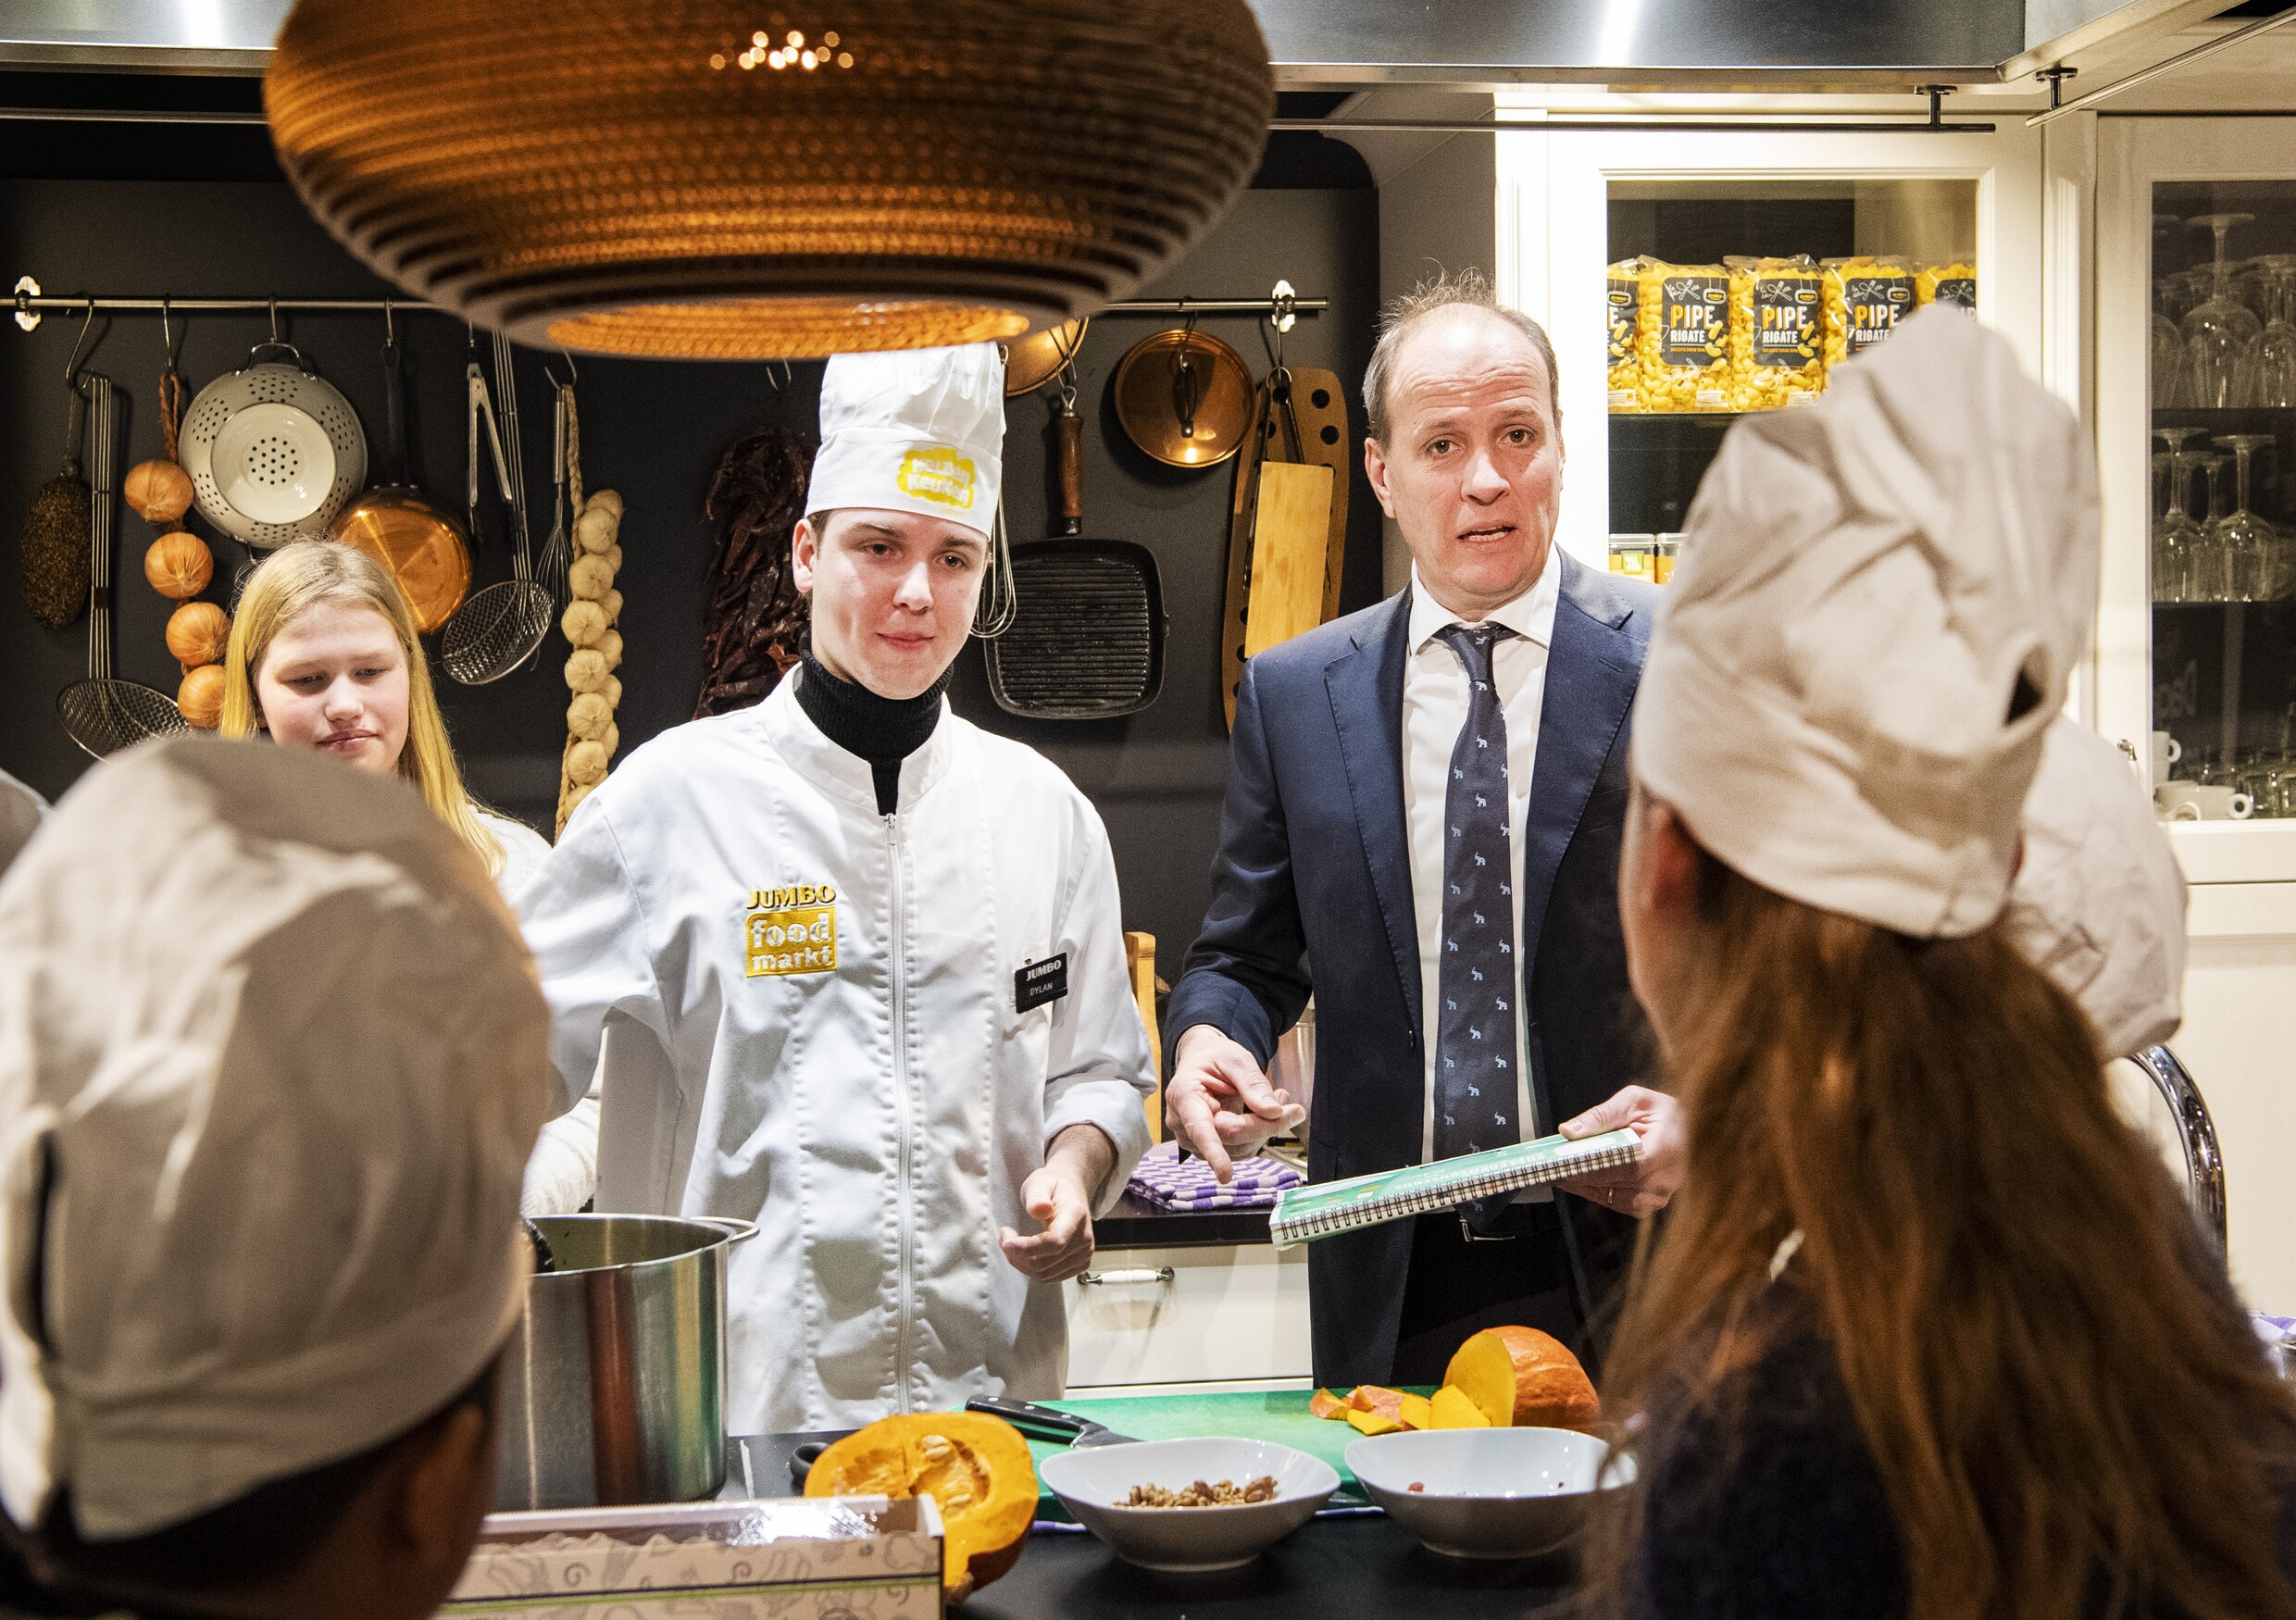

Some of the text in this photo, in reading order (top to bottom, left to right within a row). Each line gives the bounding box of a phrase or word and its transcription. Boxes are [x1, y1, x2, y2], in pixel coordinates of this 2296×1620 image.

[1670, 304, 1716, 330] PIPE
[1762, 305, 1808, 330] PIPE
[1854, 304, 1901, 330] PIPE
[1670, 330, 1705, 343] RIGATE
[1762, 330, 1798, 343] RIGATE
[1855, 329, 1890, 343] RIGATE
[746, 884, 836, 909] JUMBO
[751, 913, 831, 948] food
[752, 945, 833, 970] markt
[1026, 959, 1062, 981] JUMBO
[1029, 982, 1054, 996] DYLAN
